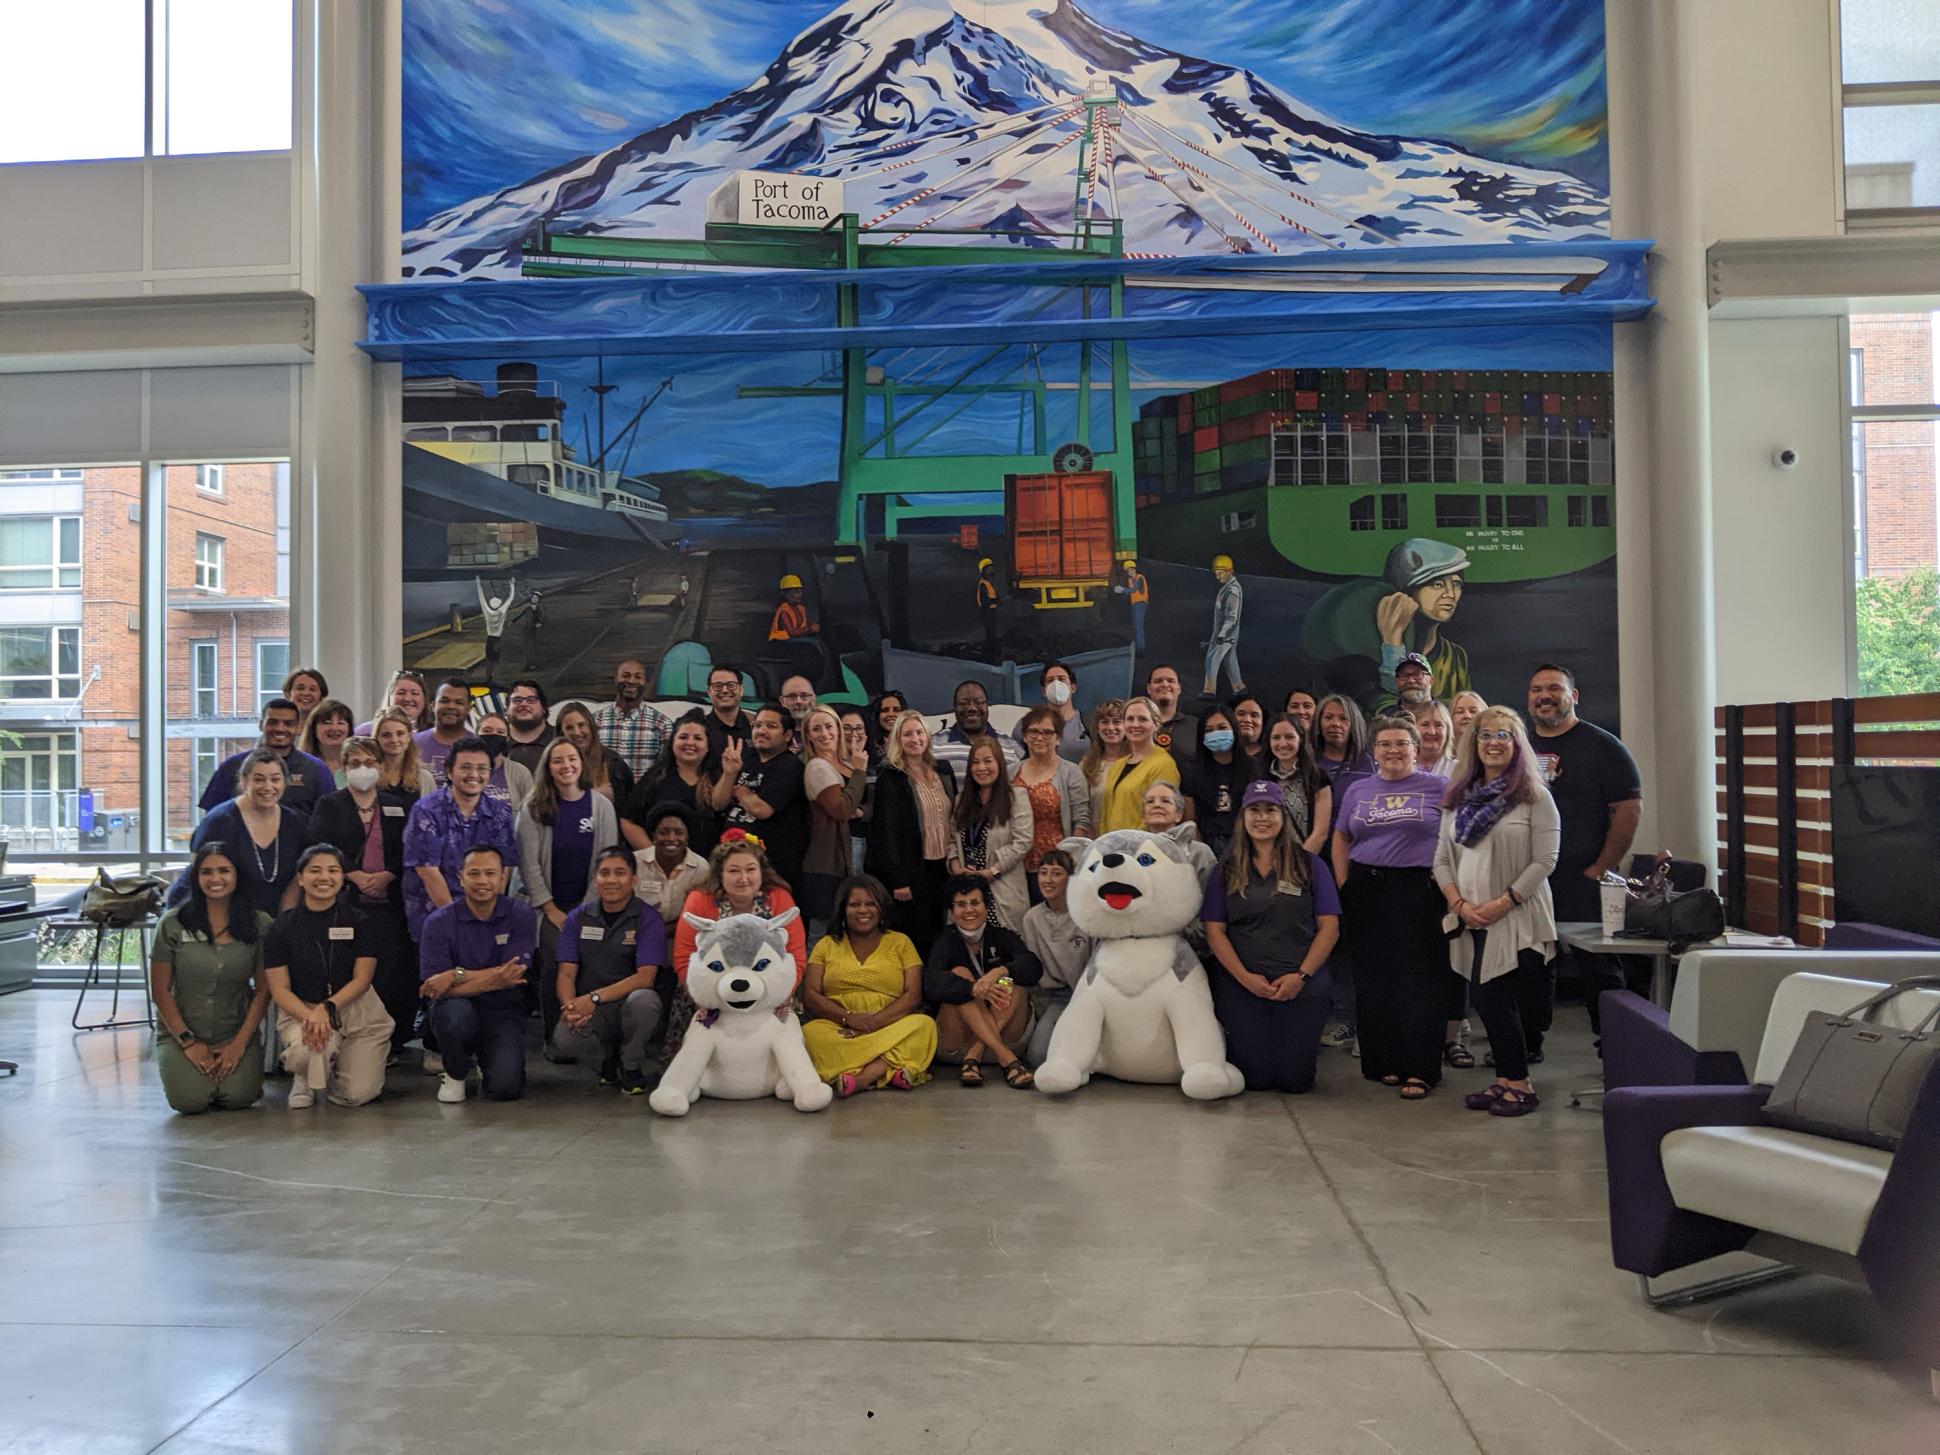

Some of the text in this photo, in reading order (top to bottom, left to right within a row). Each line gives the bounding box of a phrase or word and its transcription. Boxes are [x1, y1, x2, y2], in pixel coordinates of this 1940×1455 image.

[754, 179, 824, 201] Port of
[752, 199, 830, 220] Tacoma
[1384, 796, 1411, 809] W
[1368, 807, 1418, 822] Tacoma
